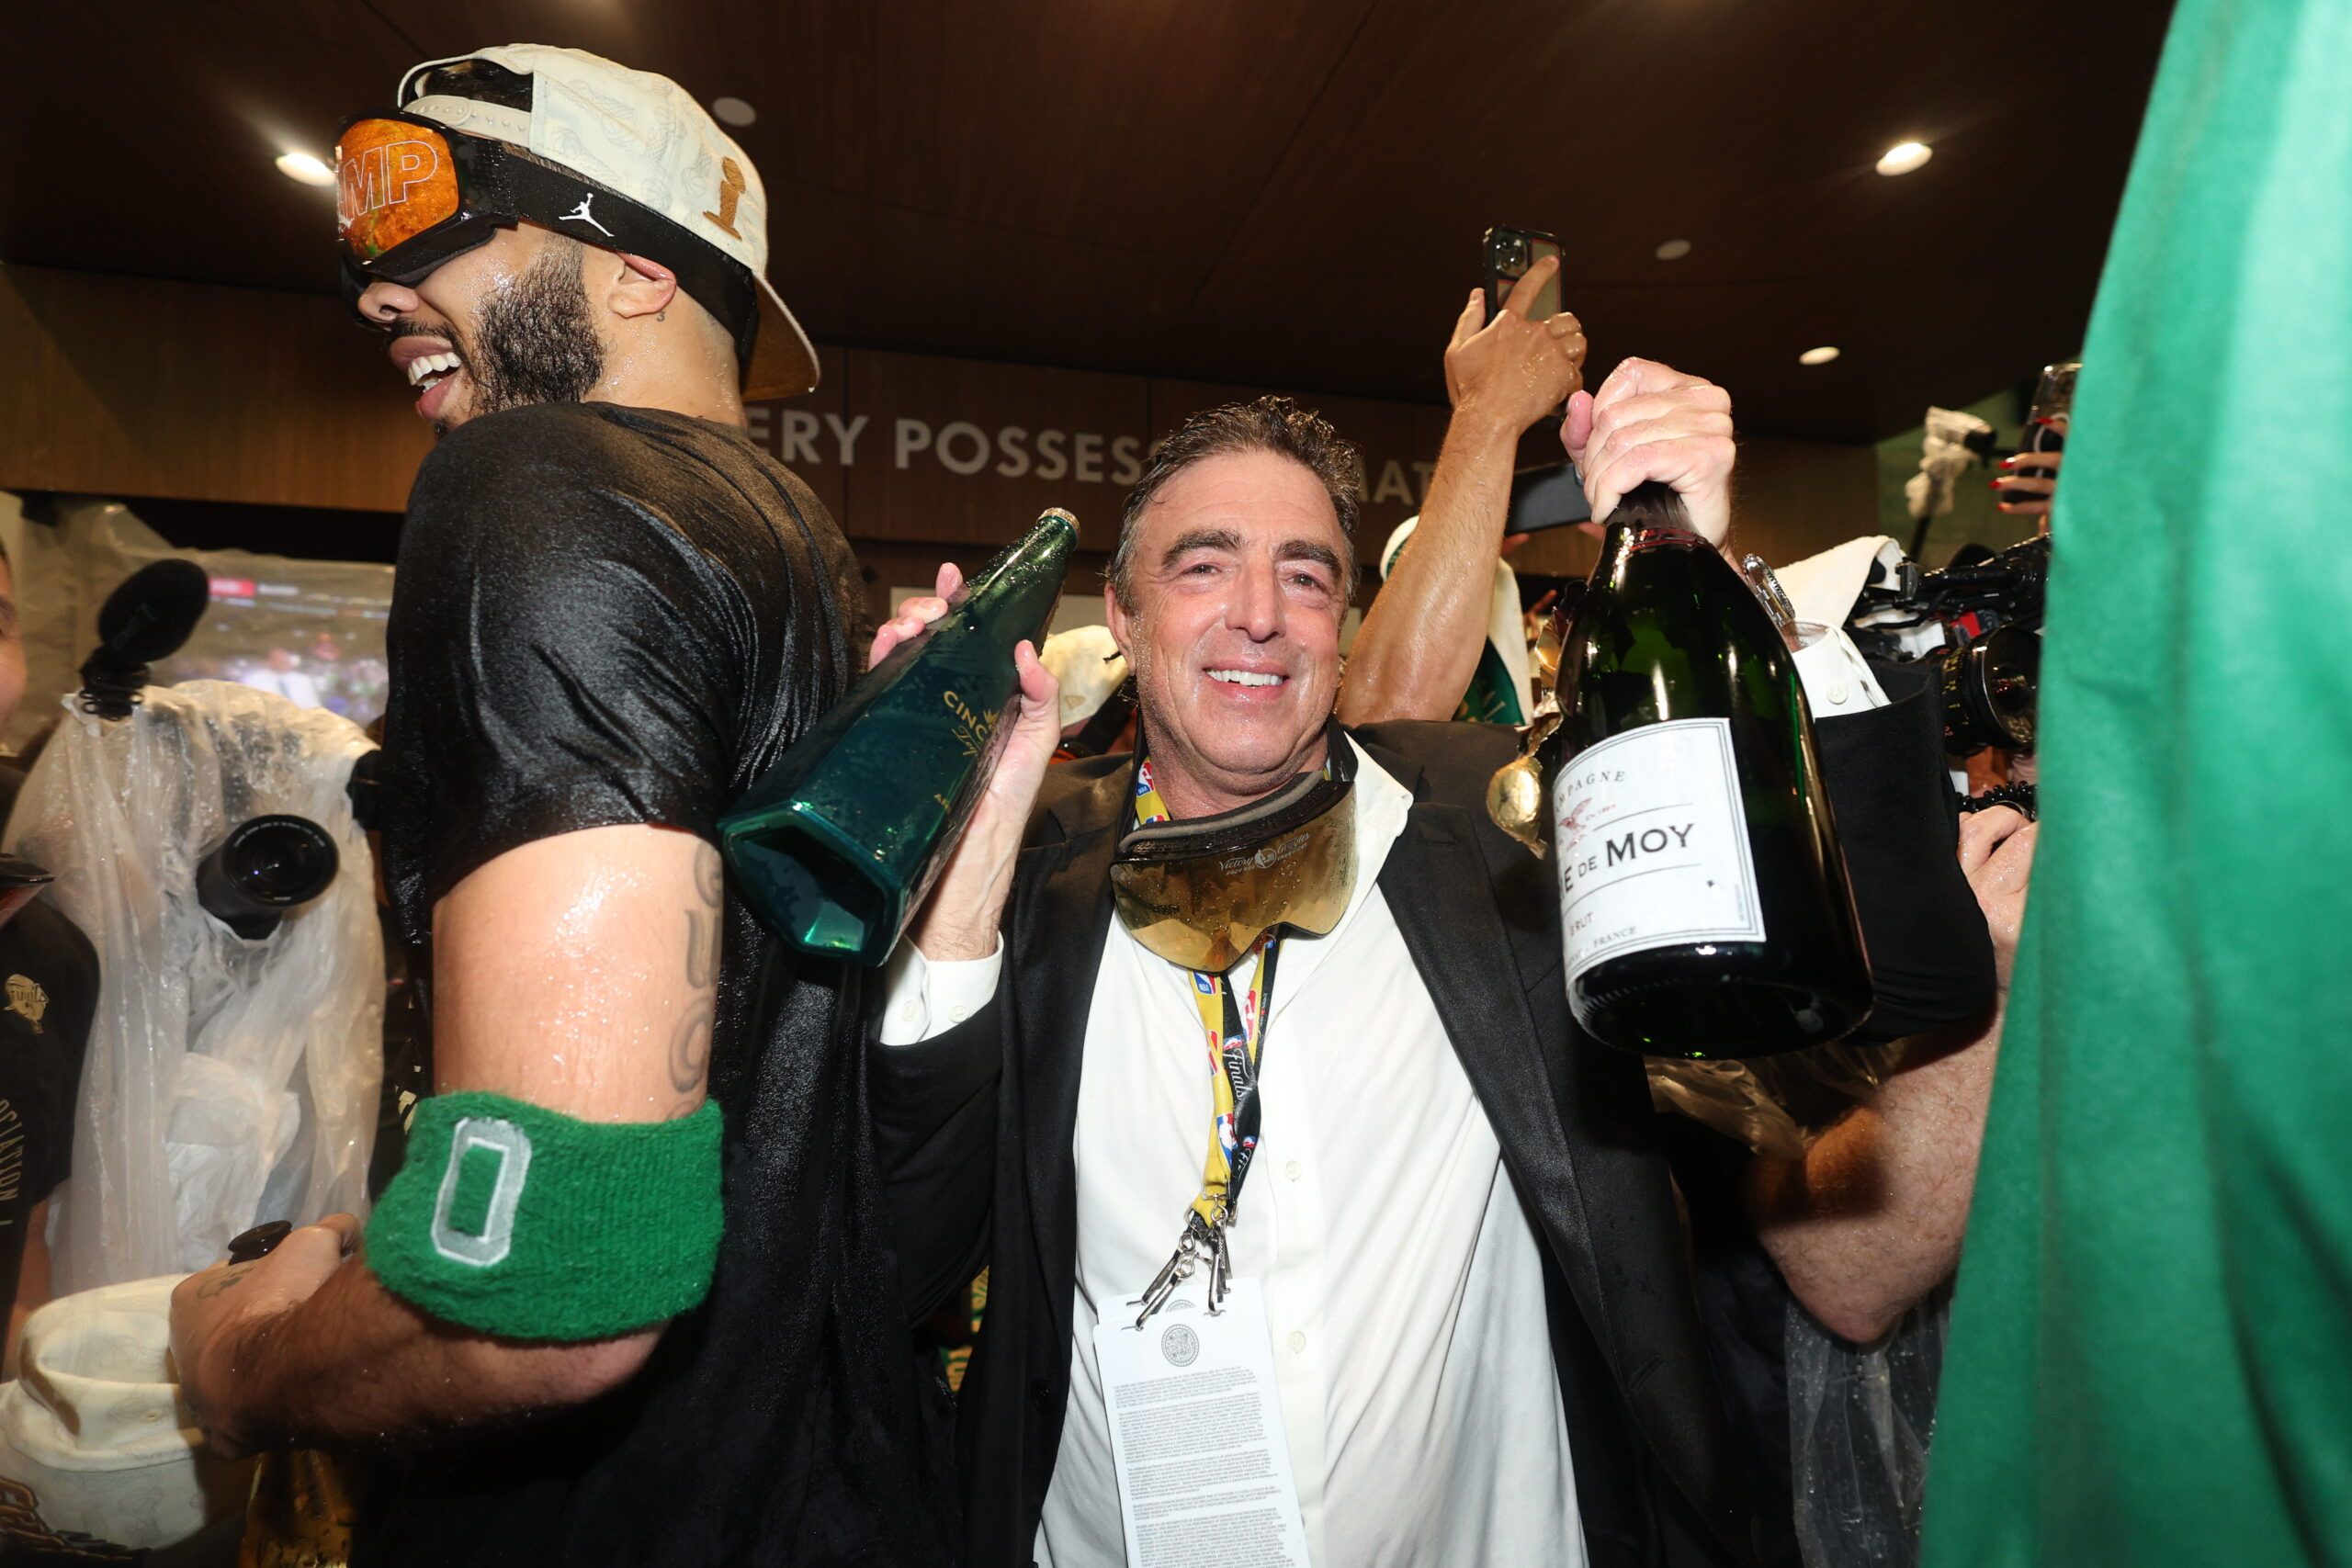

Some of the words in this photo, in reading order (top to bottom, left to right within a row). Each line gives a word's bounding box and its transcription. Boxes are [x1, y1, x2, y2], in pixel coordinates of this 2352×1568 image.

[896, 418, 1165, 487] POSSES
[944, 690, 989, 741] CINC
[1219, 856, 1254, 872] Victory
[1578, 855, 1599, 878] DE
[1606, 823, 1694, 867] MOY
[1568, 912, 1593, 937] BRUT
[1593, 927, 1635, 948] FRANCE
[1223, 1047, 1252, 1100] Finals
